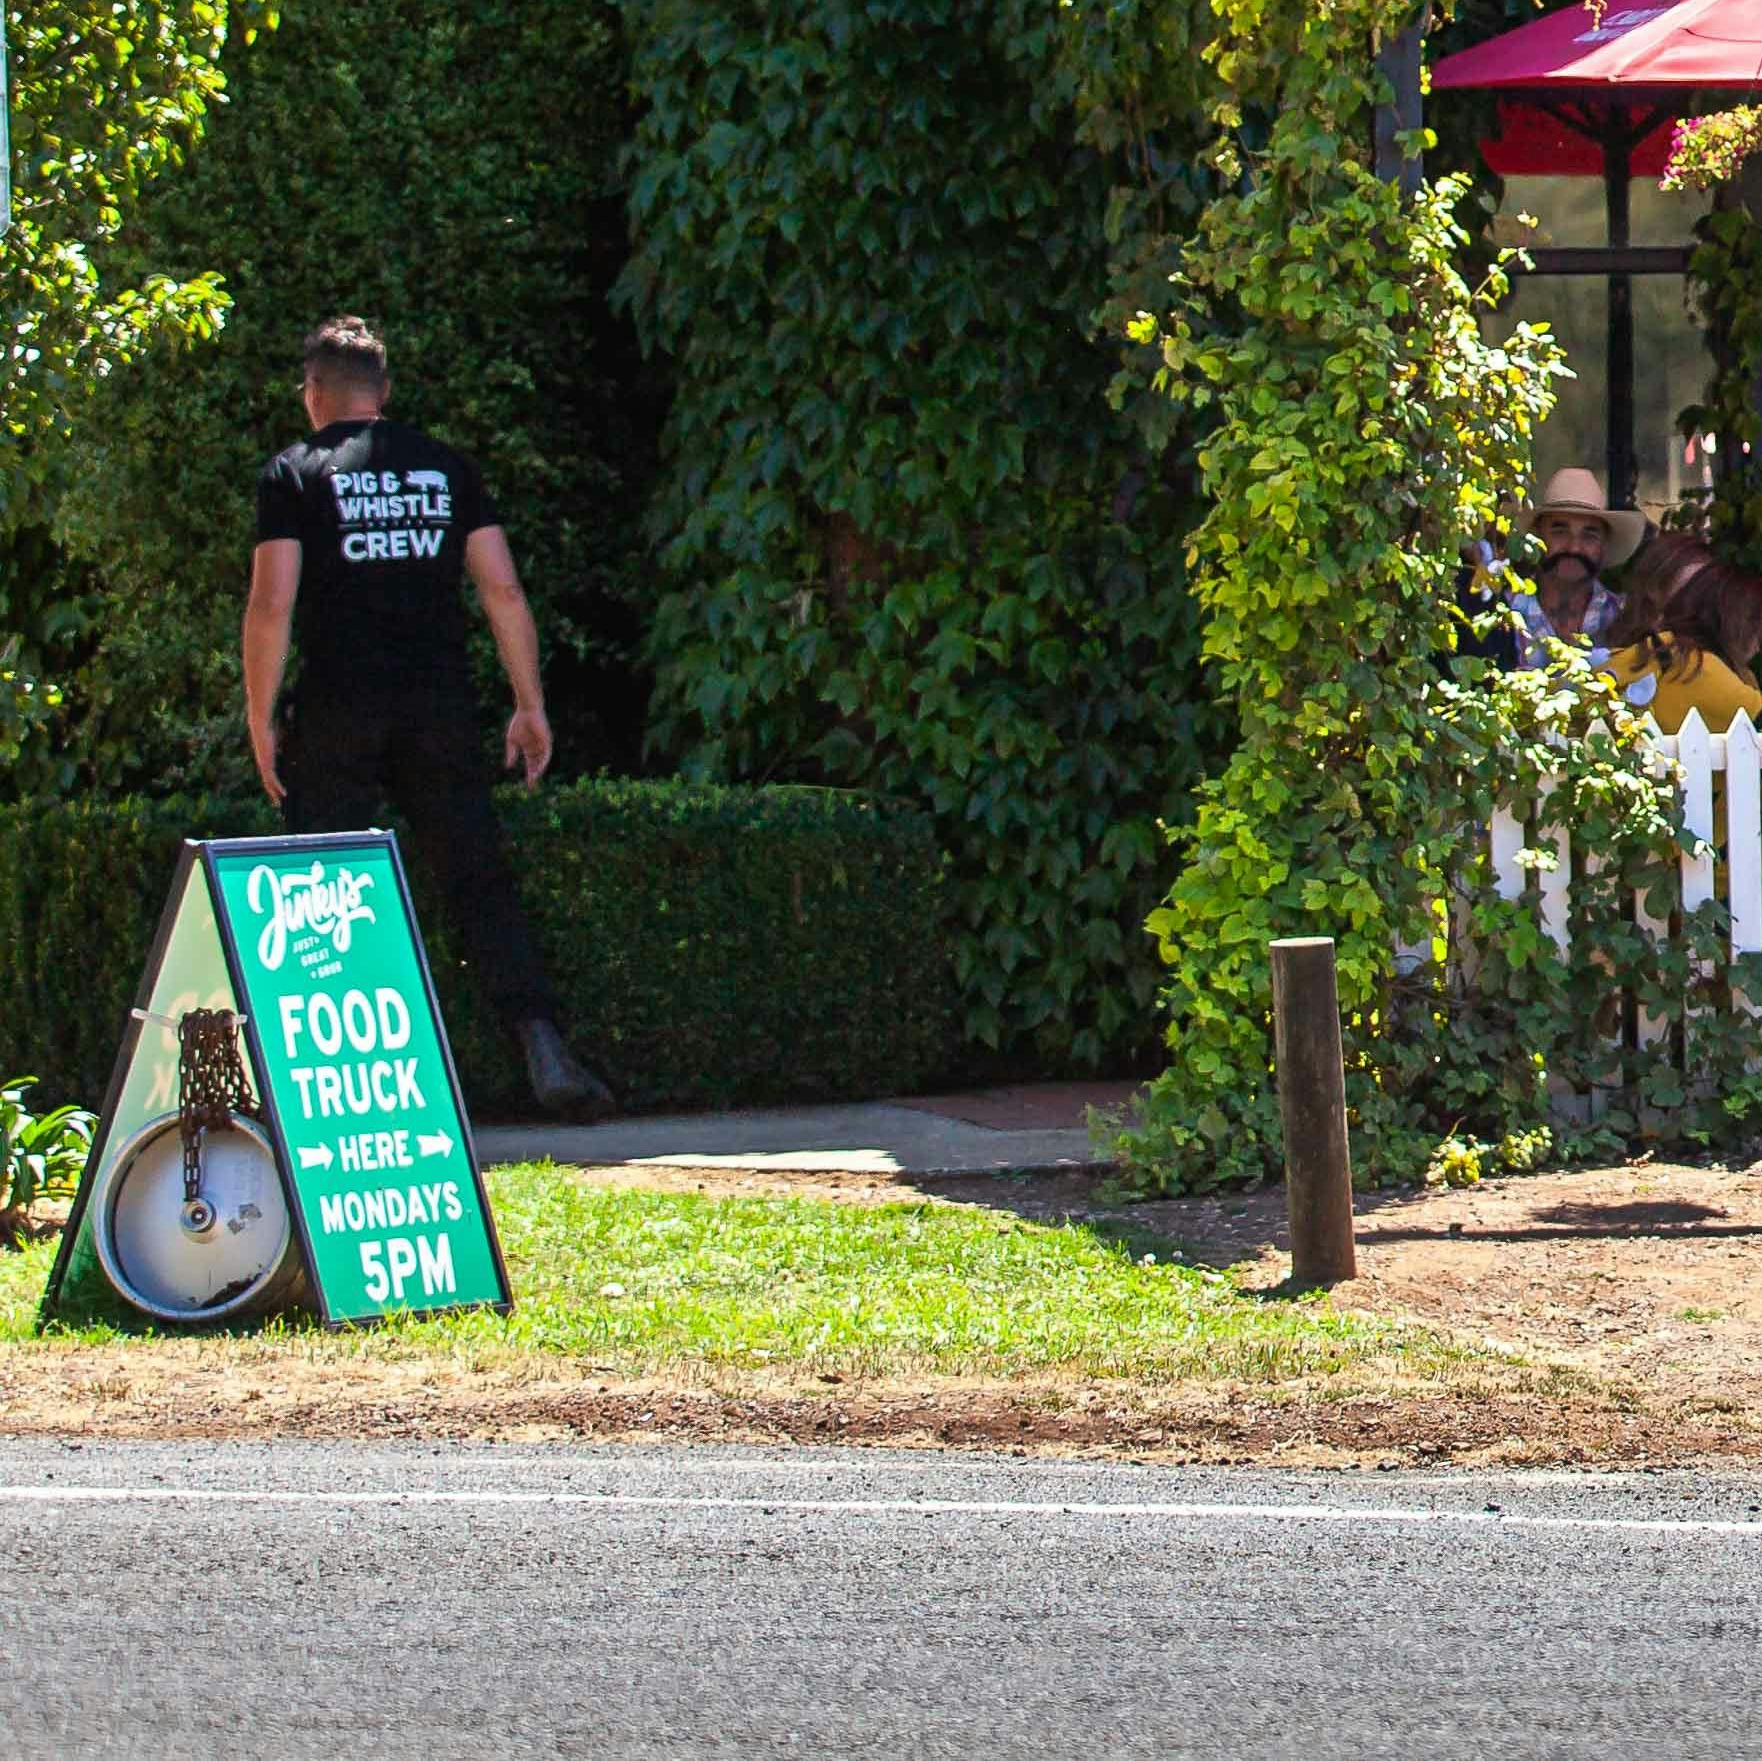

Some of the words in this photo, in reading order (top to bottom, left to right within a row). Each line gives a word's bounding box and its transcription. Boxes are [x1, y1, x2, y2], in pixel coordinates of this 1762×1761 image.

[330, 472, 378, 495] PIG
[337, 494, 452, 522] WHISTLE
[342, 529, 445, 562] CREW
[277, 986, 412, 1059] FOOD
[290, 1056, 427, 1119] TRUCK
[339, 1130, 415, 1173] HERE
[319, 1180, 464, 1235] MONDAYS
[360, 1232, 458, 1304] 5PM
